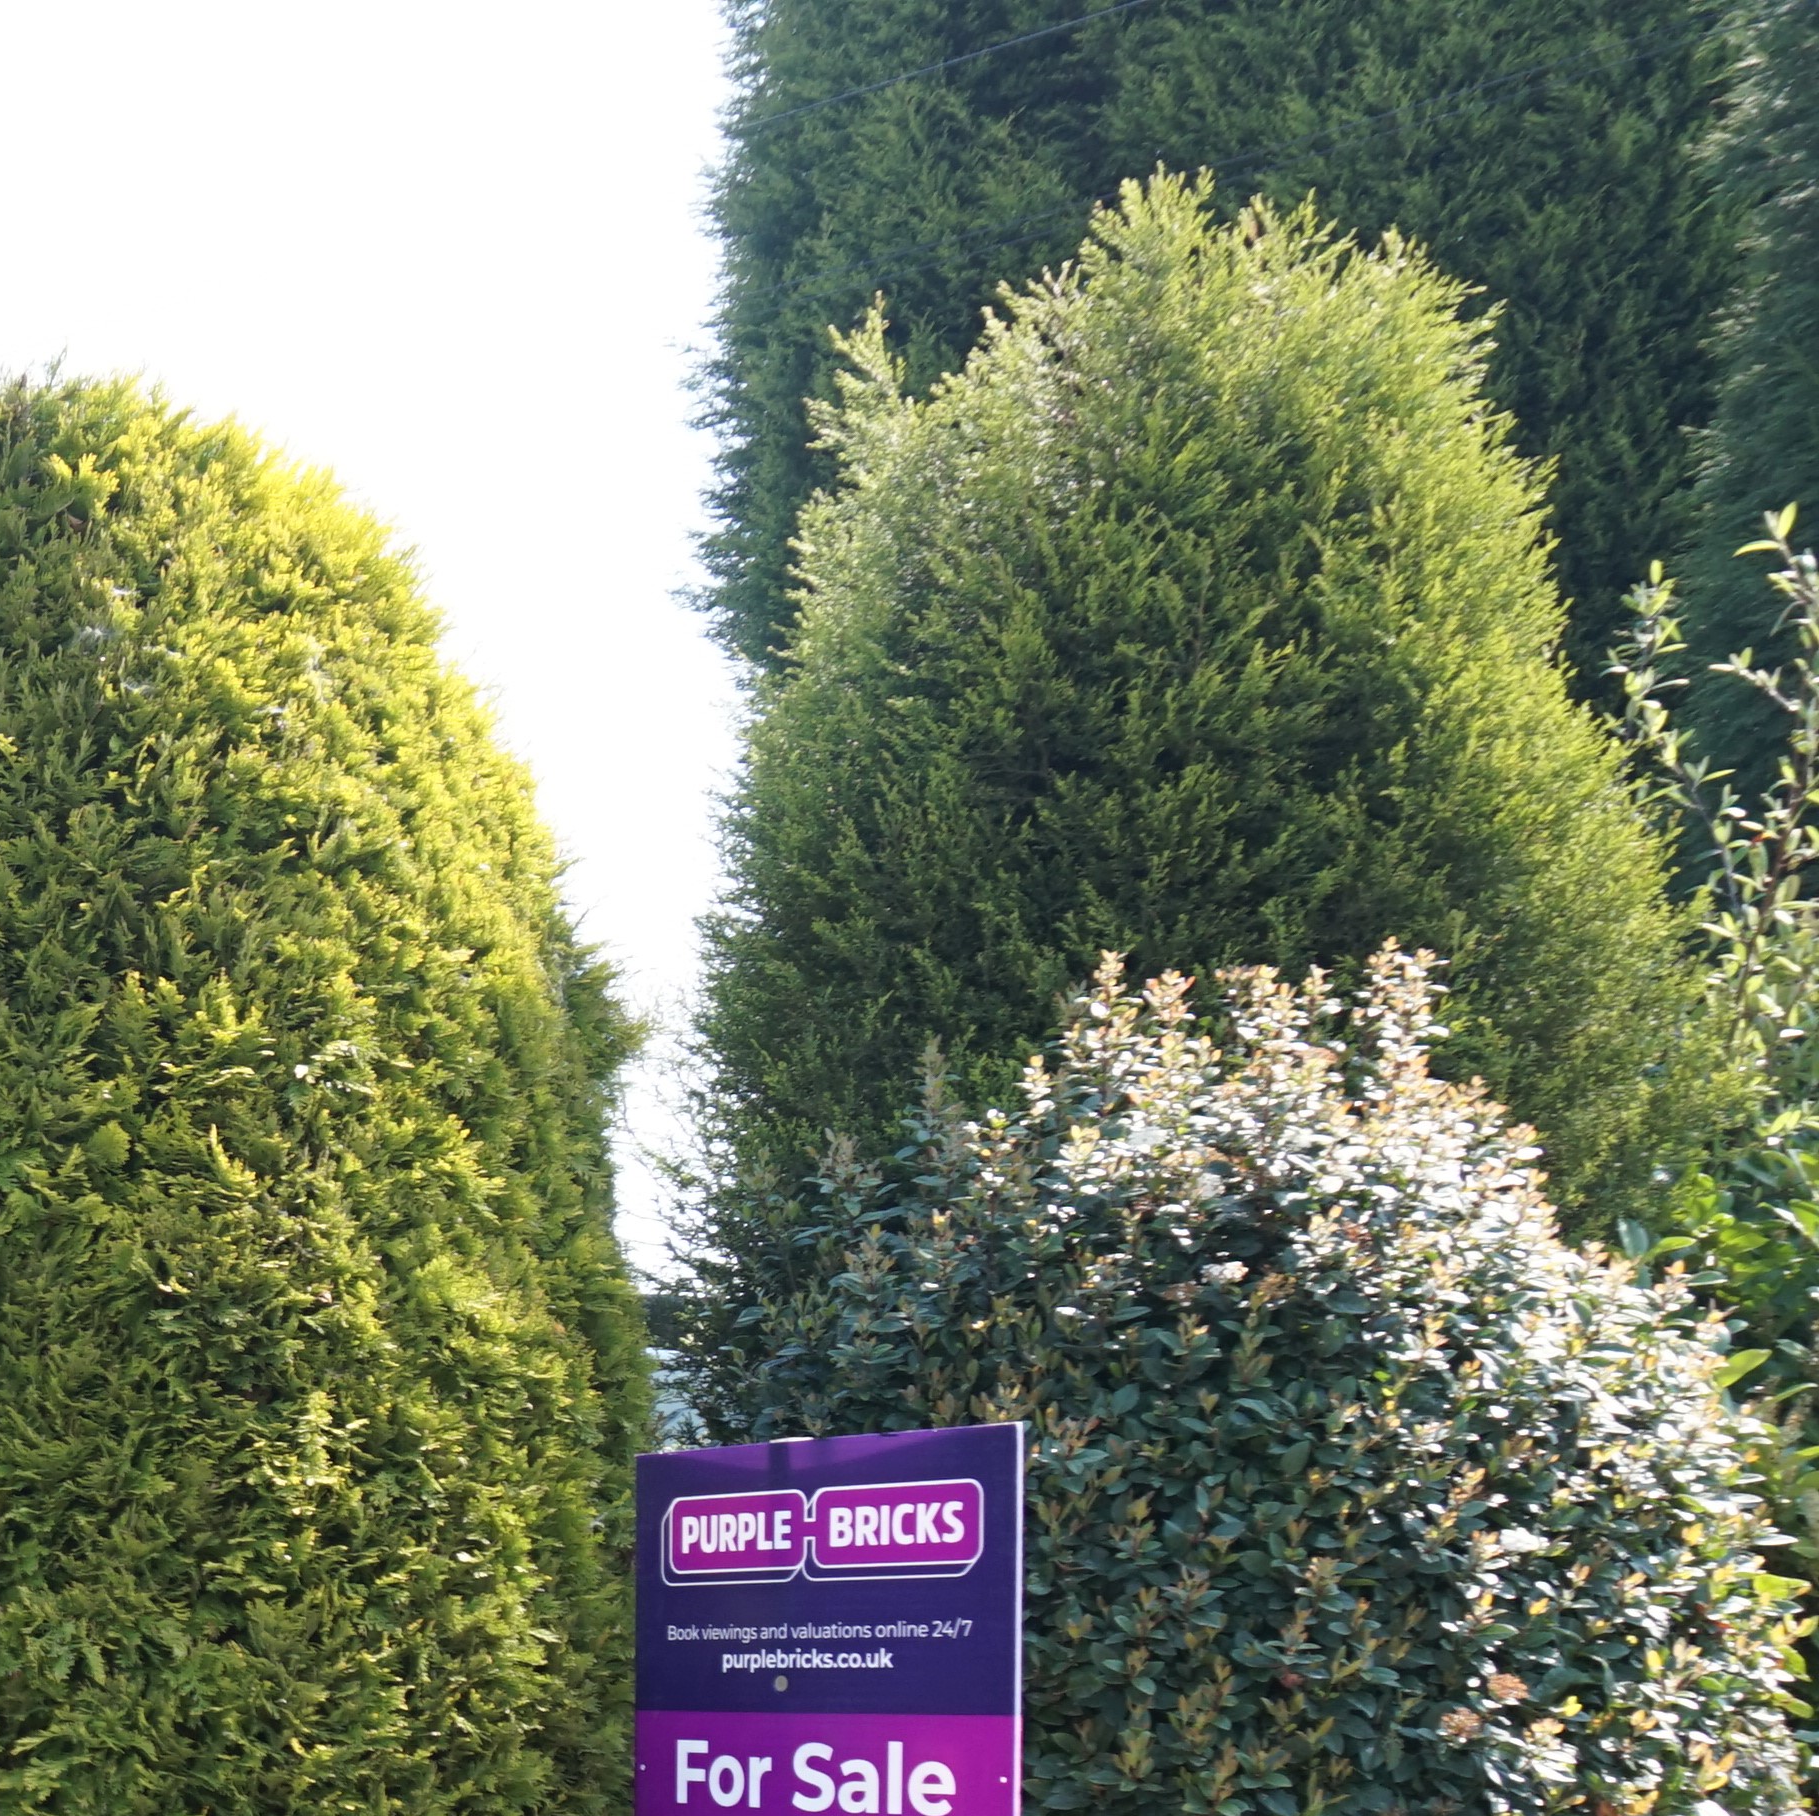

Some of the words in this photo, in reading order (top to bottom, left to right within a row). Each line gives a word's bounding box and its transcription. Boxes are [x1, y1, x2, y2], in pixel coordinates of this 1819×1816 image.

[681, 1509, 792, 1555] PURPLE
[829, 1500, 965, 1548] BRICKS
[667, 1623, 700, 1641] Book
[701, 1623, 758, 1643] viewings
[759, 1622, 788, 1640] and
[791, 1621, 872, 1640] valuations
[875, 1620, 930, 1639] online
[932, 1617, 973, 1639] 24/7
[722, 1647, 894, 1673] purplebricks.co.uk
[675, 1739, 772, 1809] For
